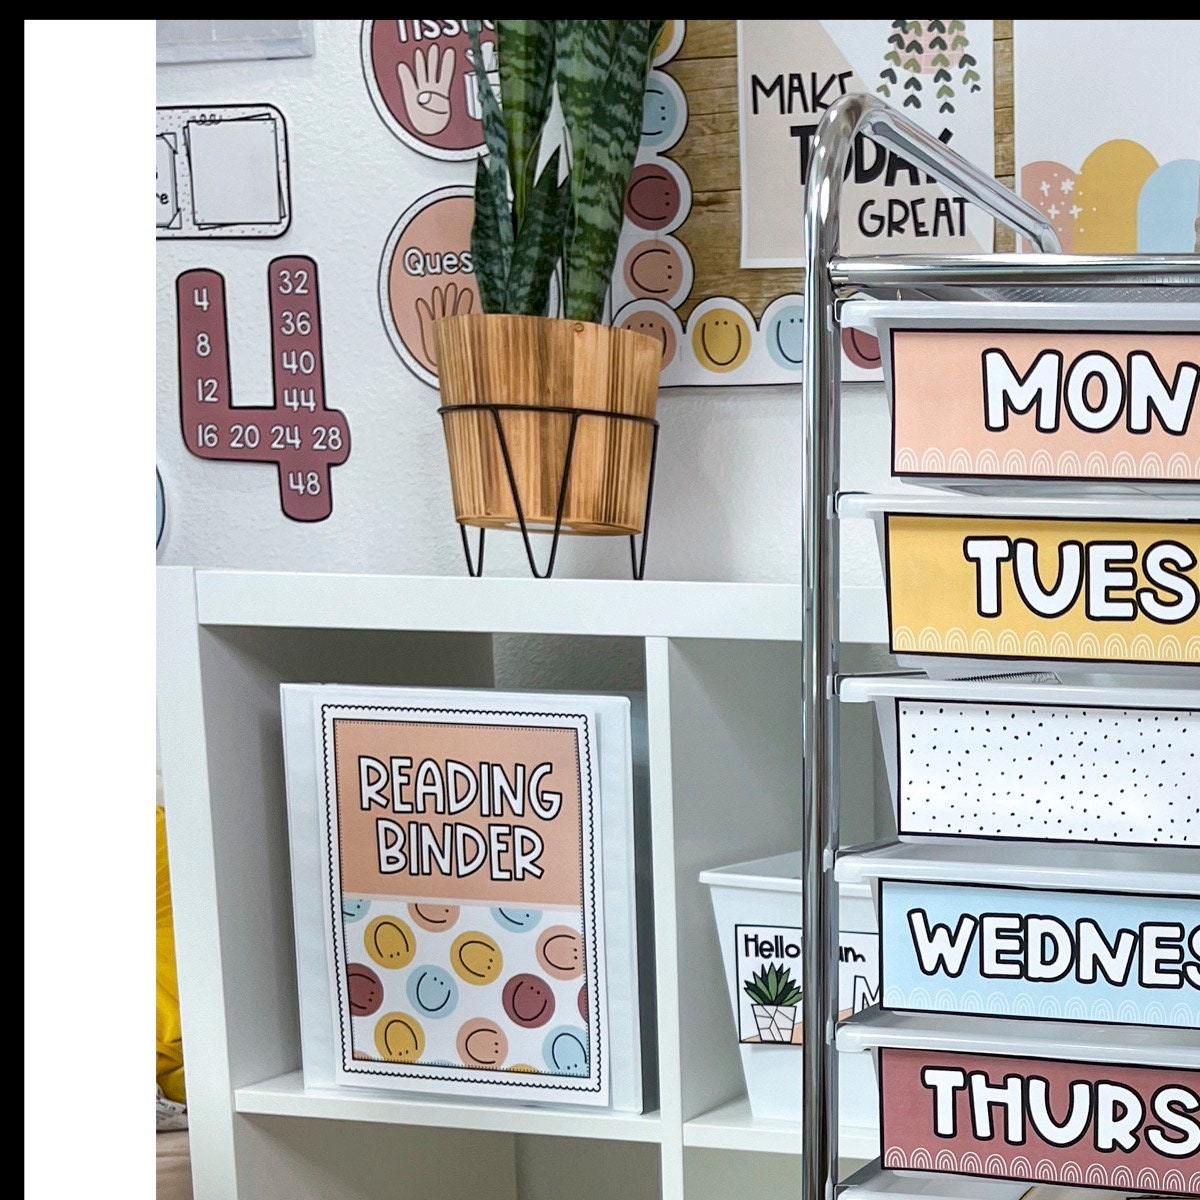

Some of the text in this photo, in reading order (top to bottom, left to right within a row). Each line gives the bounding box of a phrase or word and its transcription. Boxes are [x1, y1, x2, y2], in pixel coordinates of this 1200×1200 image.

[858, 197, 971, 238] GREAT
[278, 270, 309, 295] 32
[193, 288, 210, 311] 4
[280, 311, 312, 336] 36
[196, 332, 211, 357] 8
[281, 350, 316, 375] 40
[196, 378, 219, 402] 12
[283, 388, 316, 413] 44
[196, 424, 343, 451] 16 20 24 28
[288, 471, 321, 496] 48
[357, 755, 563, 820] READING
[375, 818, 545, 881] BINDER
[744, 934, 801, 959] Hello
